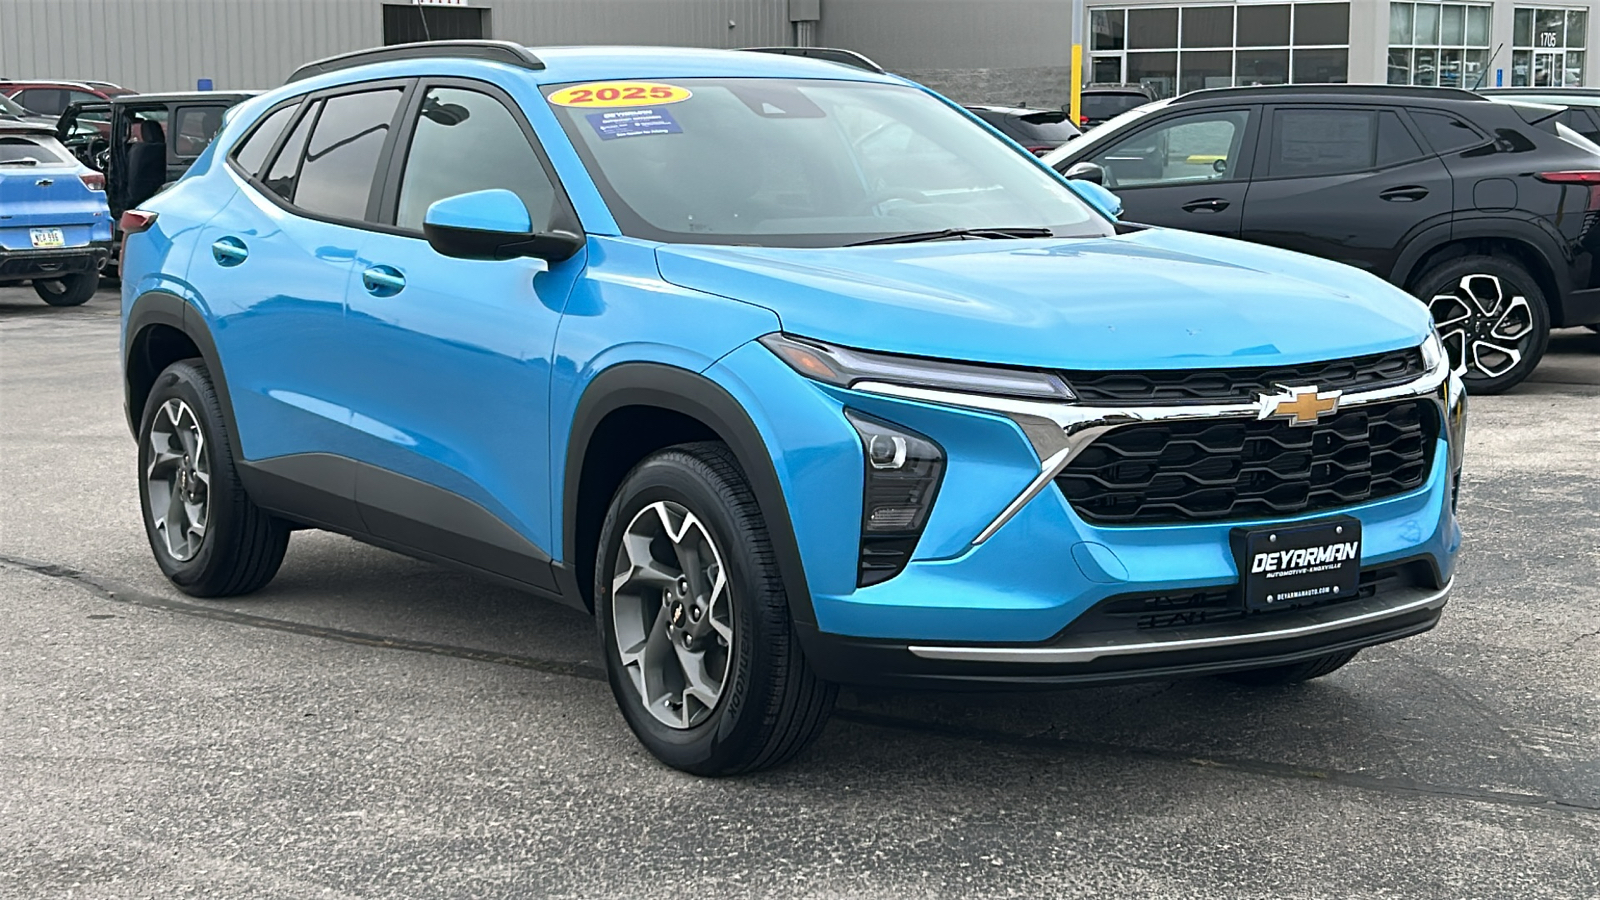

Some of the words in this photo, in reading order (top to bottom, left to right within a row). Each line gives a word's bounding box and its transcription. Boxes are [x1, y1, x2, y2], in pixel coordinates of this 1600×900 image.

[568, 87, 673, 104] 2025
[1251, 541, 1358, 573] DEYARMAN
[1277, 586, 1330, 601] DEYARMANAUTO.COM
